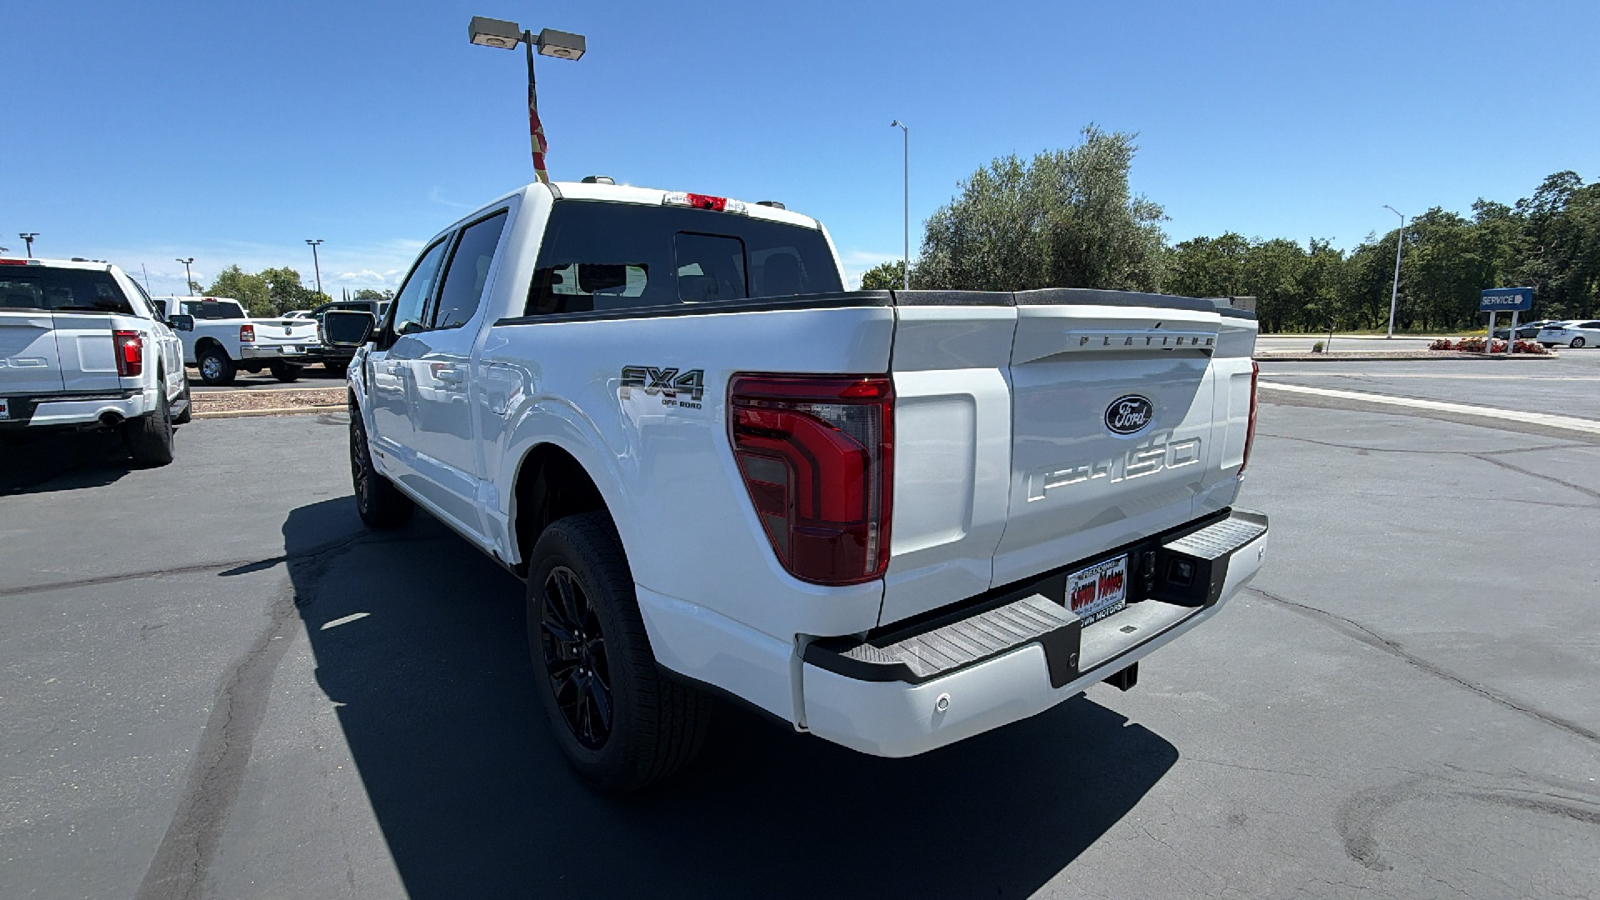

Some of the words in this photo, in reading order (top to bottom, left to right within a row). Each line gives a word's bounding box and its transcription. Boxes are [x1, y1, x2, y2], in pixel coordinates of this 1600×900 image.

[1482, 295, 1513, 305] SERVICE
[1080, 336, 1214, 346] PLATINUM
[620, 366, 704, 401] FX4
[679, 401, 702, 410] ROAD
[1115, 401, 1147, 427] Ford
